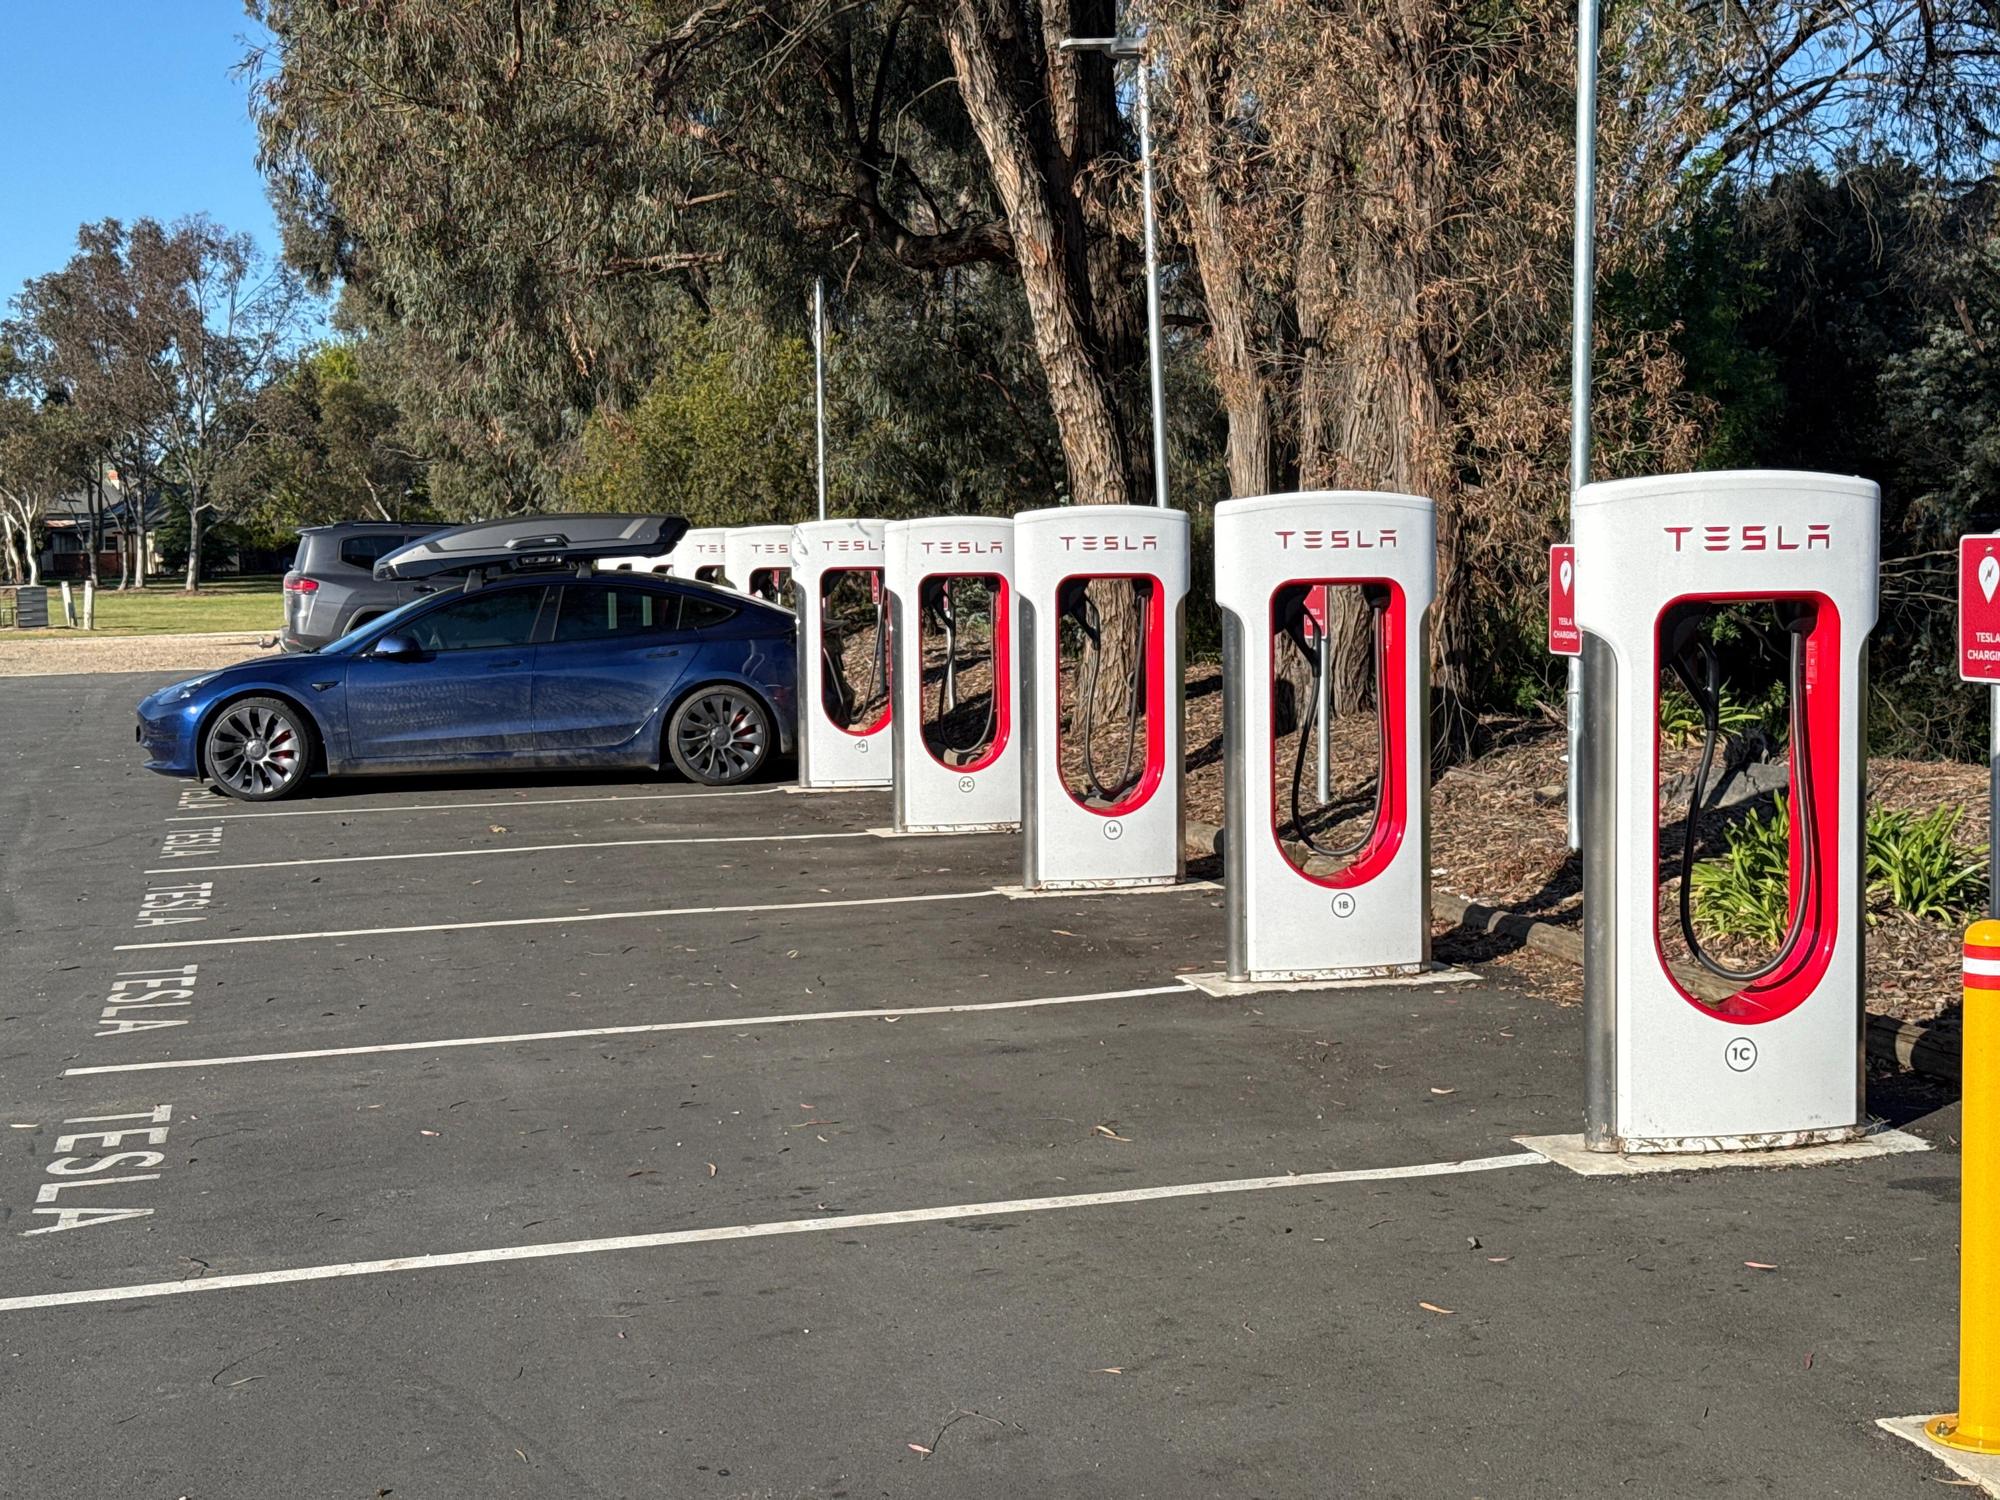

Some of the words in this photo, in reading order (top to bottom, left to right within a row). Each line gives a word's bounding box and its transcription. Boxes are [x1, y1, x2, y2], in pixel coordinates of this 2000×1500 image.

[1060, 536, 1157, 551] TESLA
[1275, 529, 1397, 550] TESLA
[1663, 524, 1830, 552] TESLA
[921, 541, 1003, 554] TESLA
[1975, 632, 2000, 643] TESLA
[961, 780, 972, 788] 2C
[1108, 825, 1118, 833] 1A
[160, 826, 223, 858] TESLA
[134, 881, 213, 928] TESLA
[1338, 901, 1349, 909] 1B
[95, 964, 198, 1037] TESLA
[1732, 1047, 1751, 1061] 1C
[20, 1103, 172, 1236] TESLA
